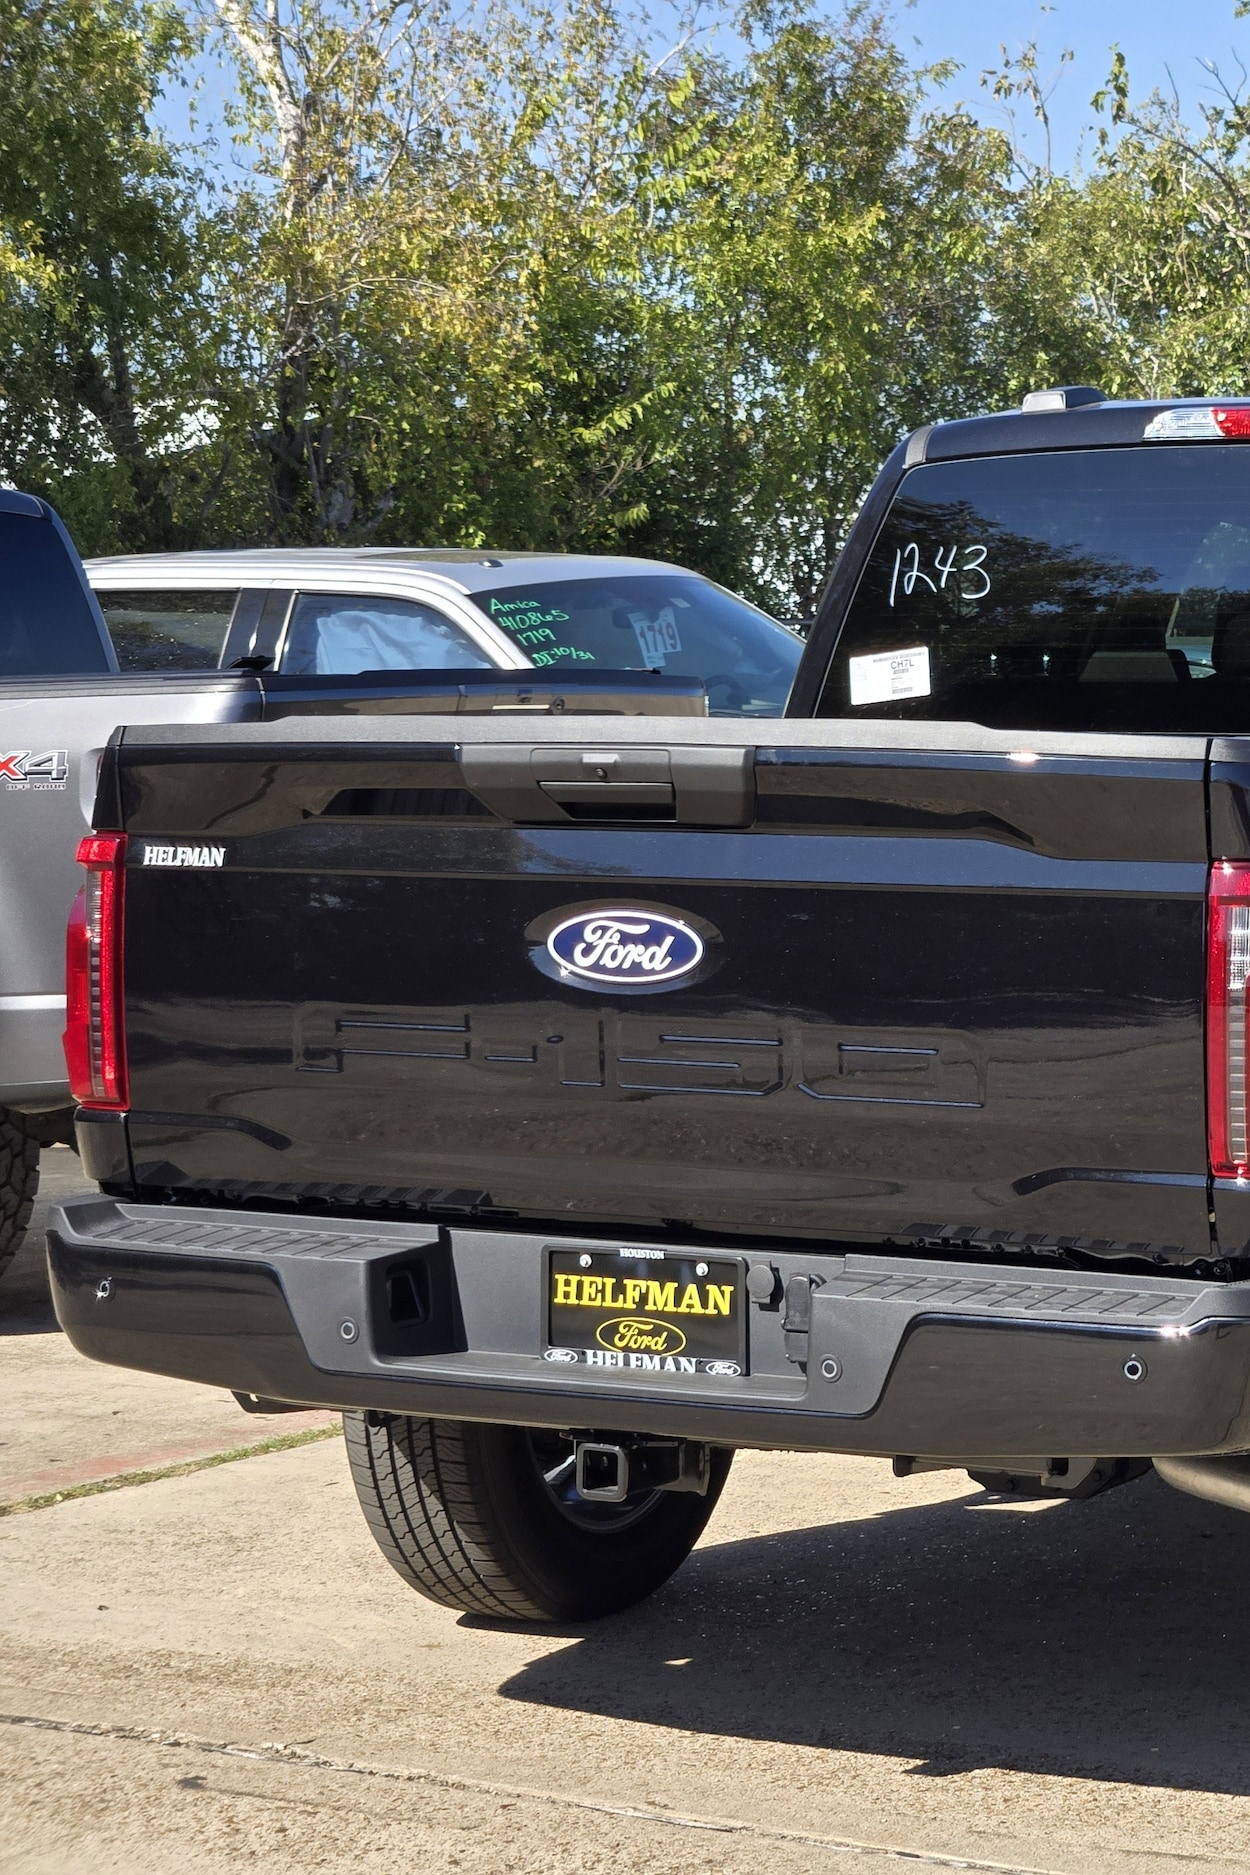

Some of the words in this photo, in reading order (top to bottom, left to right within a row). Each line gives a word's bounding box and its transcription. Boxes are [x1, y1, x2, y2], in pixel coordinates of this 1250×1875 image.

[889, 542, 991, 607] 1243
[490, 598, 541, 614] Amica
[498, 610, 570, 630] 410865
[516, 628, 556, 646] 1719
[640, 622, 677, 654] 1719
[143, 846, 226, 867] HELFMAN
[573, 919, 676, 971] Ford
[619, 1248, 665, 1260] HOUSTON
[554, 1274, 734, 1316] HELFMAN
[614, 1321, 668, 1351] Ford
[585, 1350, 697, 1373] HELFMAN
